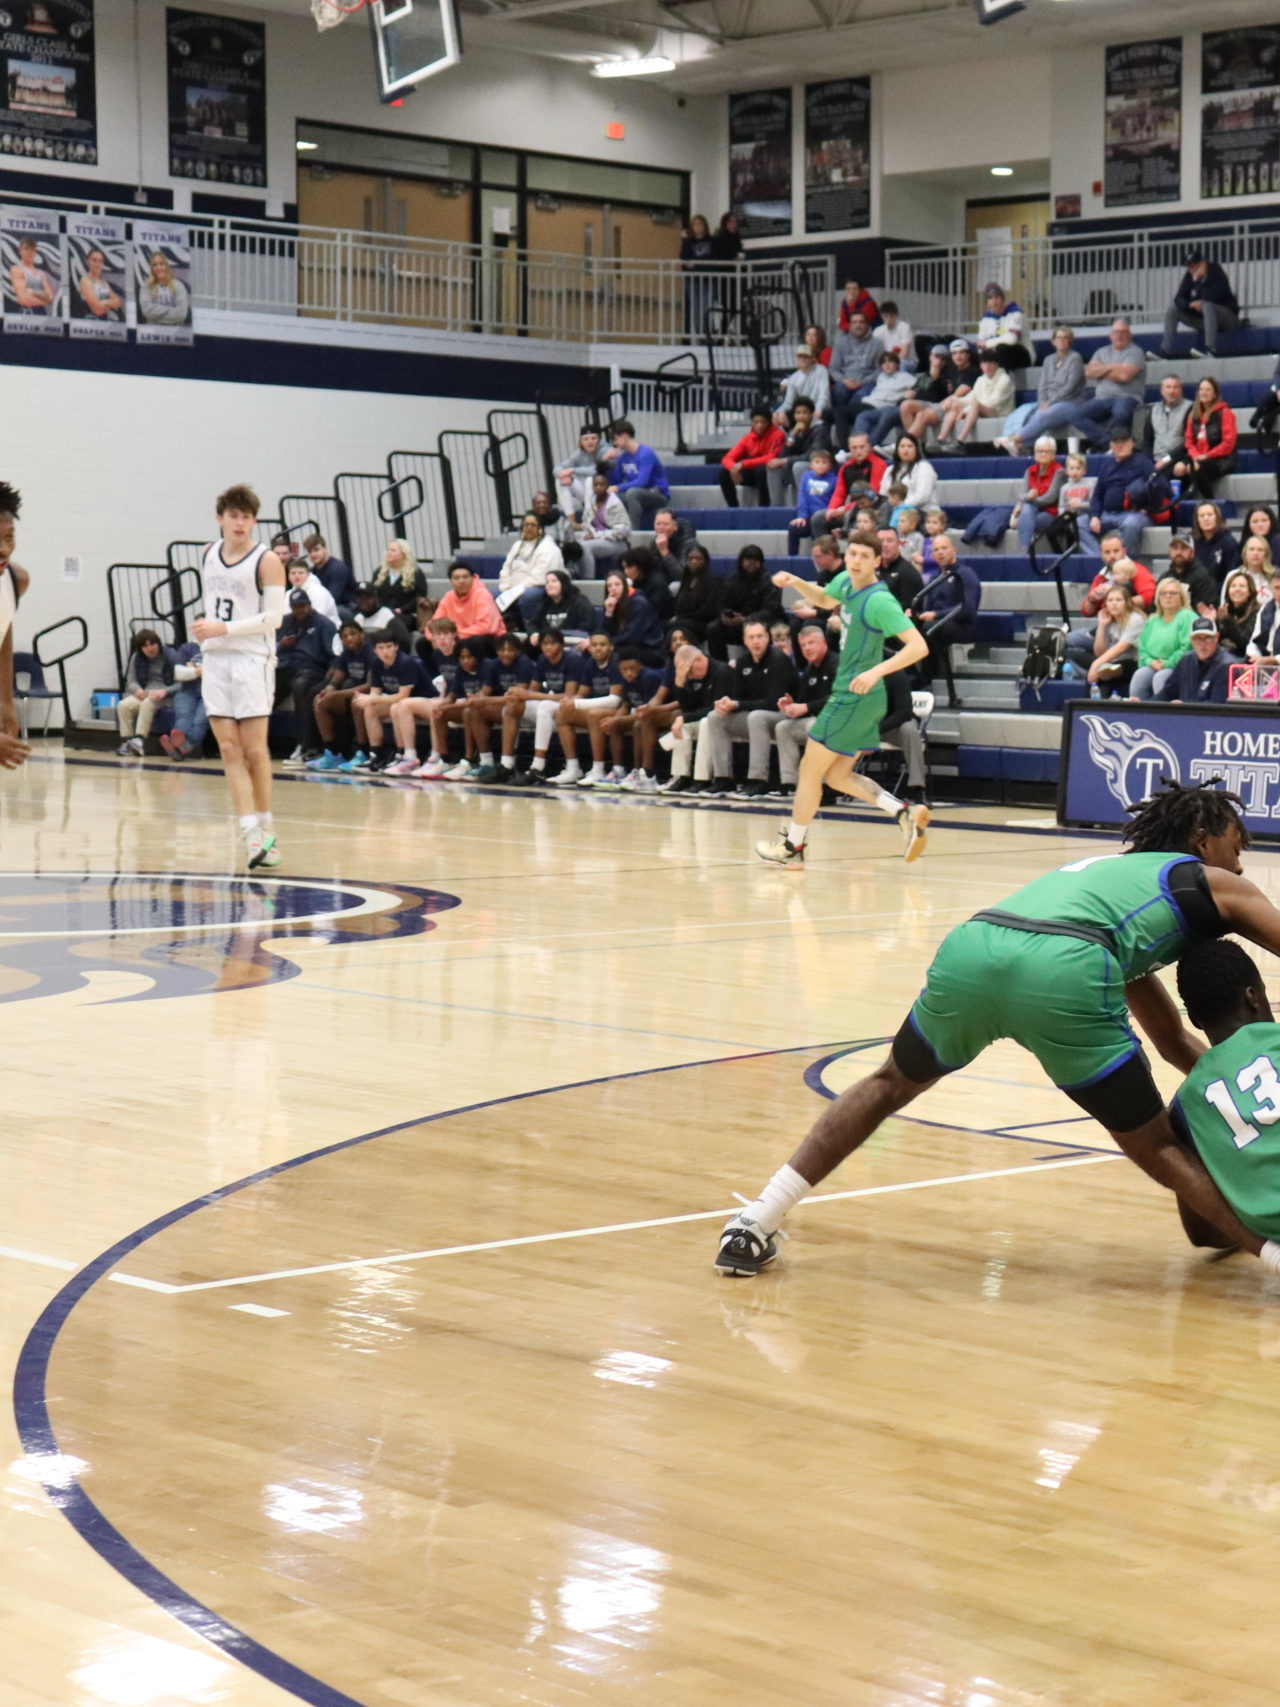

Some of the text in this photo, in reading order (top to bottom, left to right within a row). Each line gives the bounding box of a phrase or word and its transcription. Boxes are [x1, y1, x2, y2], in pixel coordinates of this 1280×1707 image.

[8, 219, 51, 231] TITANS
[75, 225, 117, 237] TITANS
[140, 232, 182, 244] TITANS
[215, 598, 234, 622] 13
